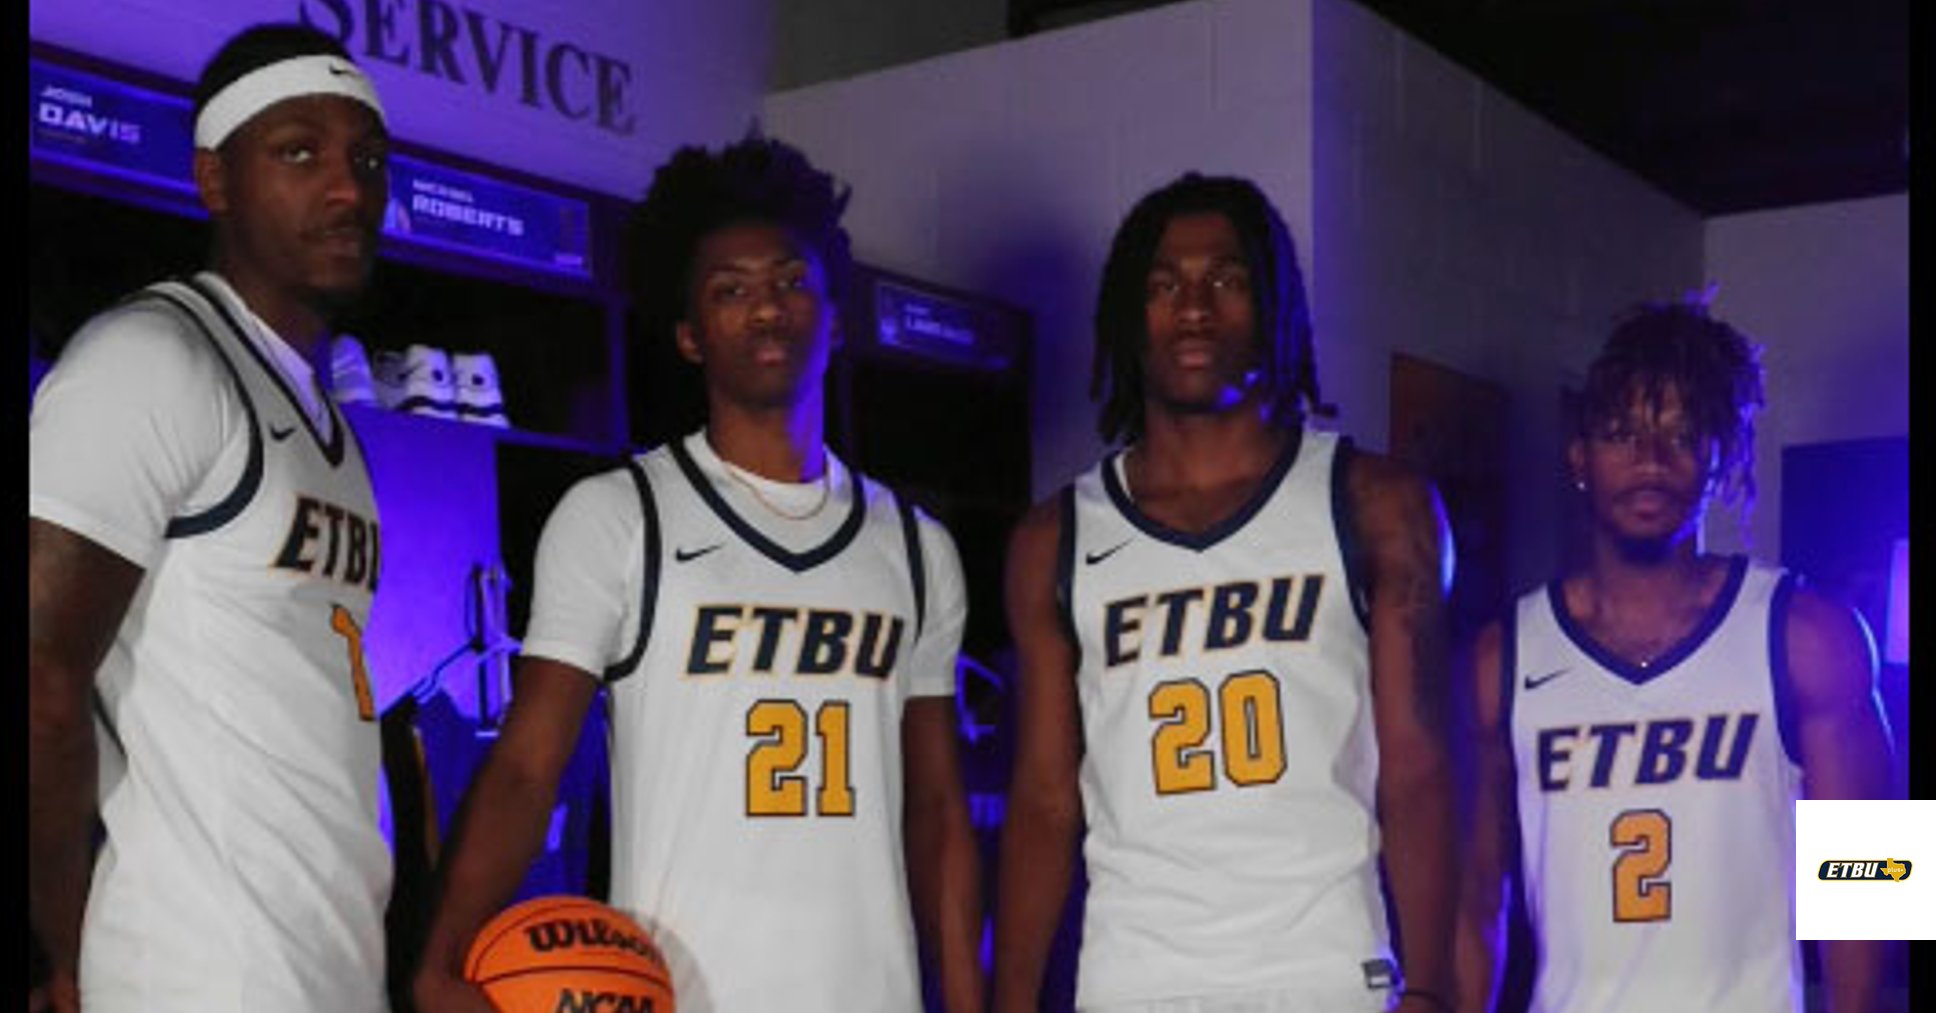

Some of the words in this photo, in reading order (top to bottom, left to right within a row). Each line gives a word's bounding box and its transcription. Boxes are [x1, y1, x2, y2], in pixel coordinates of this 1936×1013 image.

[299, 0, 637, 136] SERVICE
[39, 103, 140, 143] DAVIS
[413, 194, 525, 236] ROBERTS
[682, 603, 905, 682] ETBU
[1100, 572, 1326, 670] ETBU
[745, 698, 856, 818] 21
[1149, 669, 1288, 795] 20
[1537, 711, 1760, 793] ETBU
[1609, 808, 1673, 922] 2
